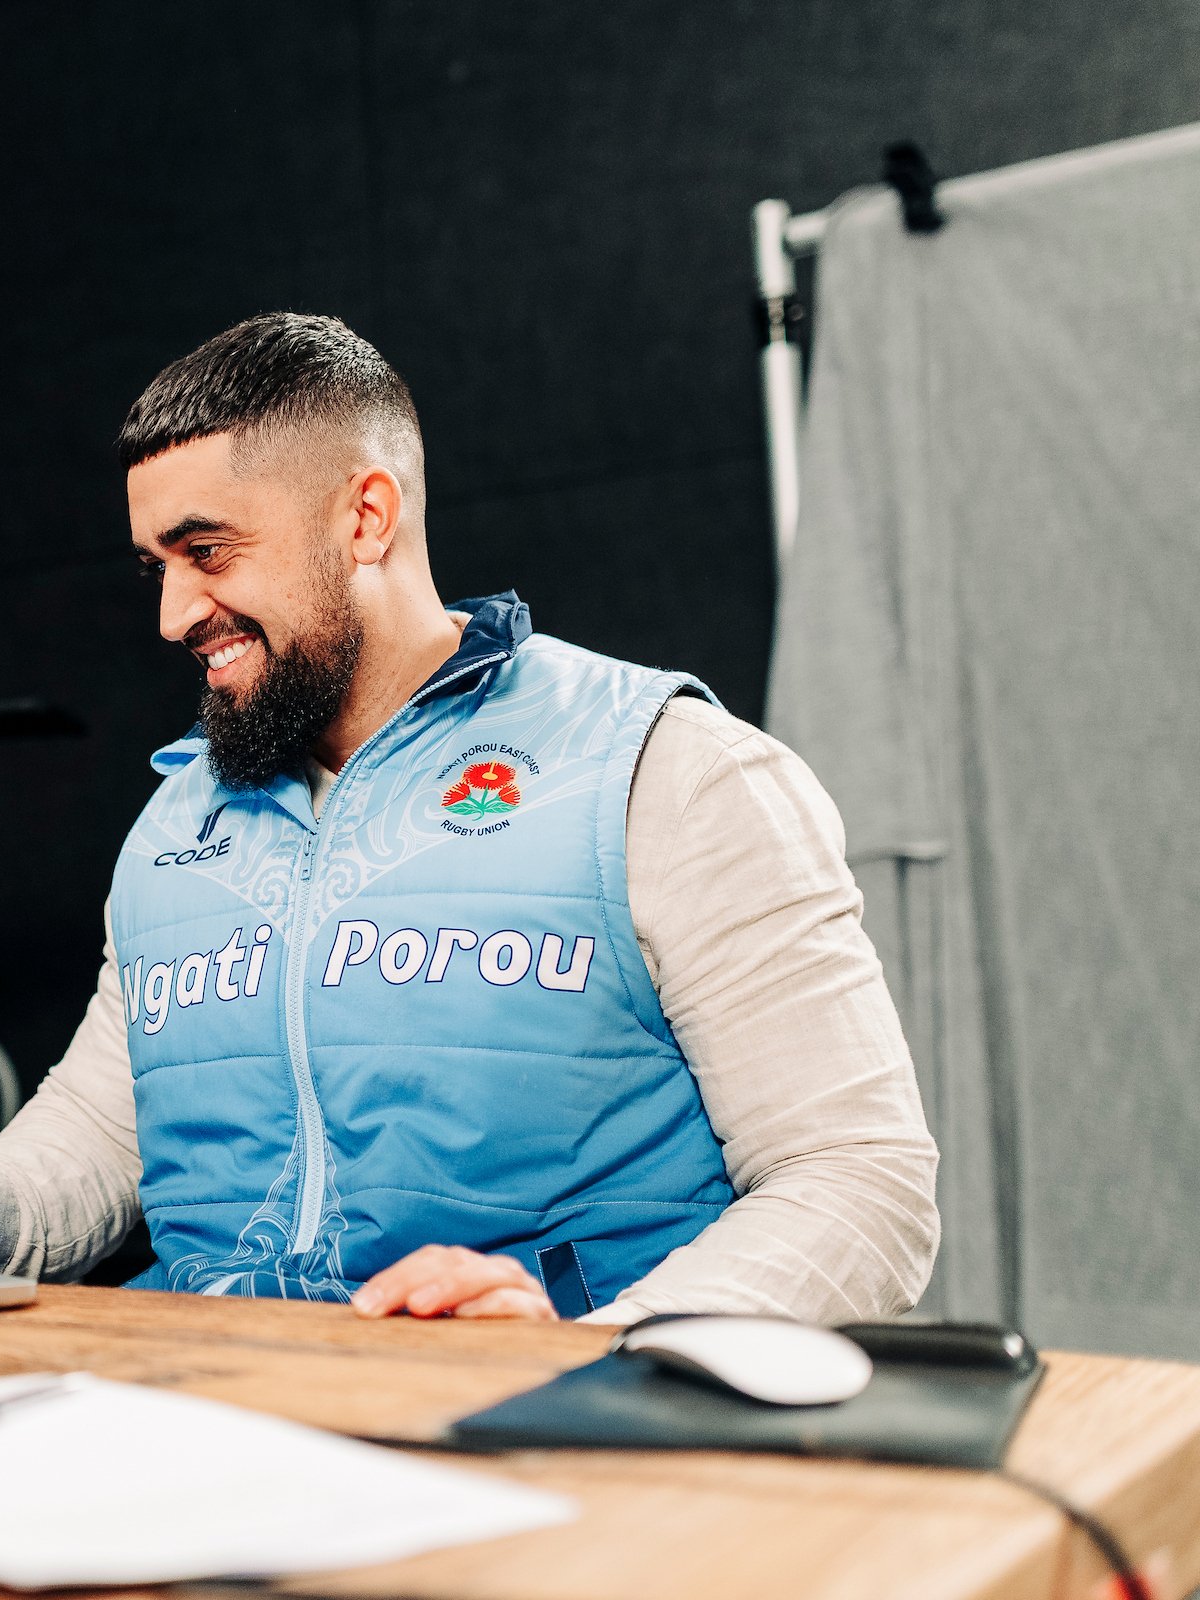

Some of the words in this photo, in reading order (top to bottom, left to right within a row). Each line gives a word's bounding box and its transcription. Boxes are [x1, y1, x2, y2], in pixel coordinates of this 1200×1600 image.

[461, 743, 497, 761] POROU
[499, 744, 524, 759] EAST
[522, 754, 540, 776] COAST
[440, 819, 475, 837] RUGBY
[477, 819, 511, 837] UNION
[154, 836, 231, 866] CODE
[122, 924, 273, 1036] Ngati
[321, 919, 595, 993] Porou
